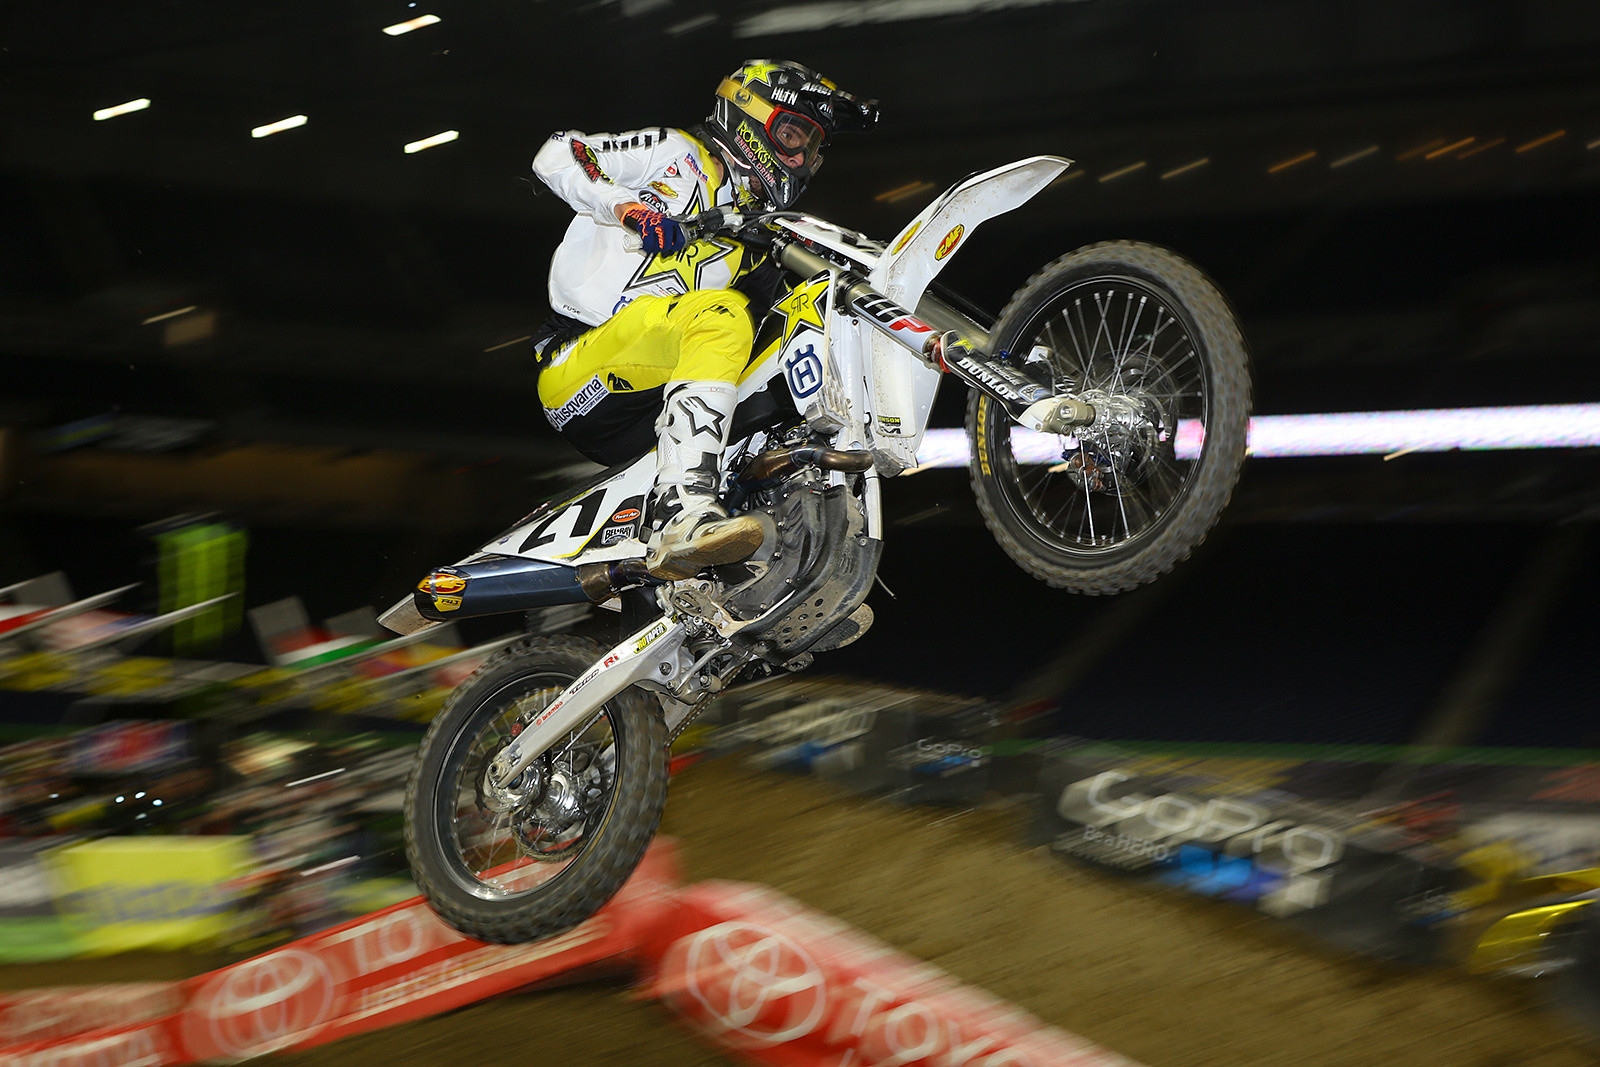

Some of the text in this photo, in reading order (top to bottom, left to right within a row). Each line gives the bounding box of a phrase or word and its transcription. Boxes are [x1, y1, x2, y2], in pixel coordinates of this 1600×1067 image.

[735, 135, 758, 162] ENERGY
[756, 162, 776, 186] DRINK
[935, 225, 964, 260] FMF
[562, 303, 581, 315] FUSE
[552, 378, 601, 424] Husqvarna
[957, 357, 1019, 401] DUNLOP
[977, 395, 992, 476] DUNLOP
[518, 488, 608, 554] 21
[542, 701, 564, 722] brembo
[1078, 768, 1338, 870] GoPro
